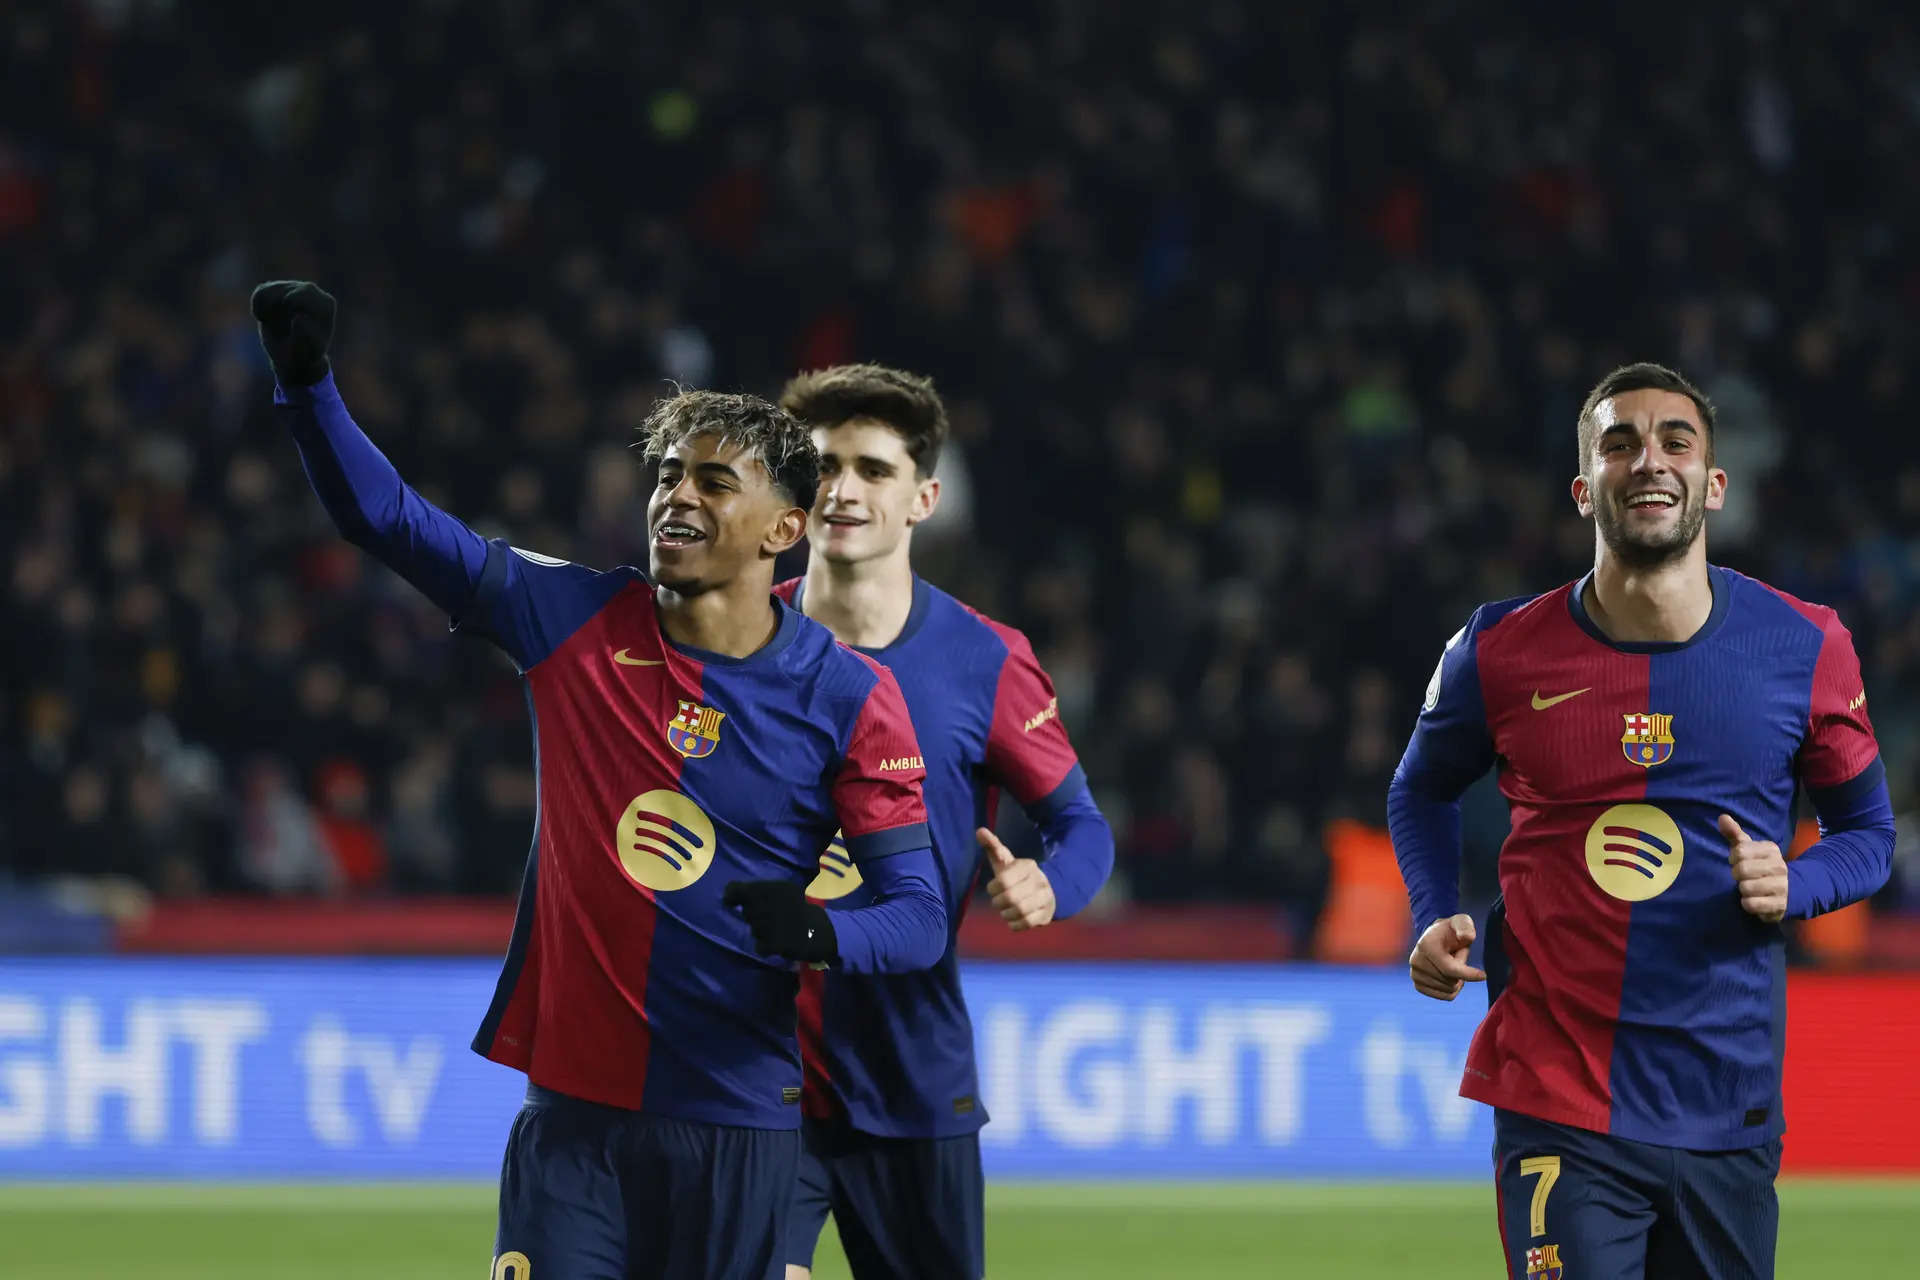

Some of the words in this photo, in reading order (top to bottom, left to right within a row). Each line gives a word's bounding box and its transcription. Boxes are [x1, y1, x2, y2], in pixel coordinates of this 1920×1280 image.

[1637, 735, 1658, 743] FCB
[298, 1014, 445, 1147] tv
[1520, 1155, 1560, 1237] 7
